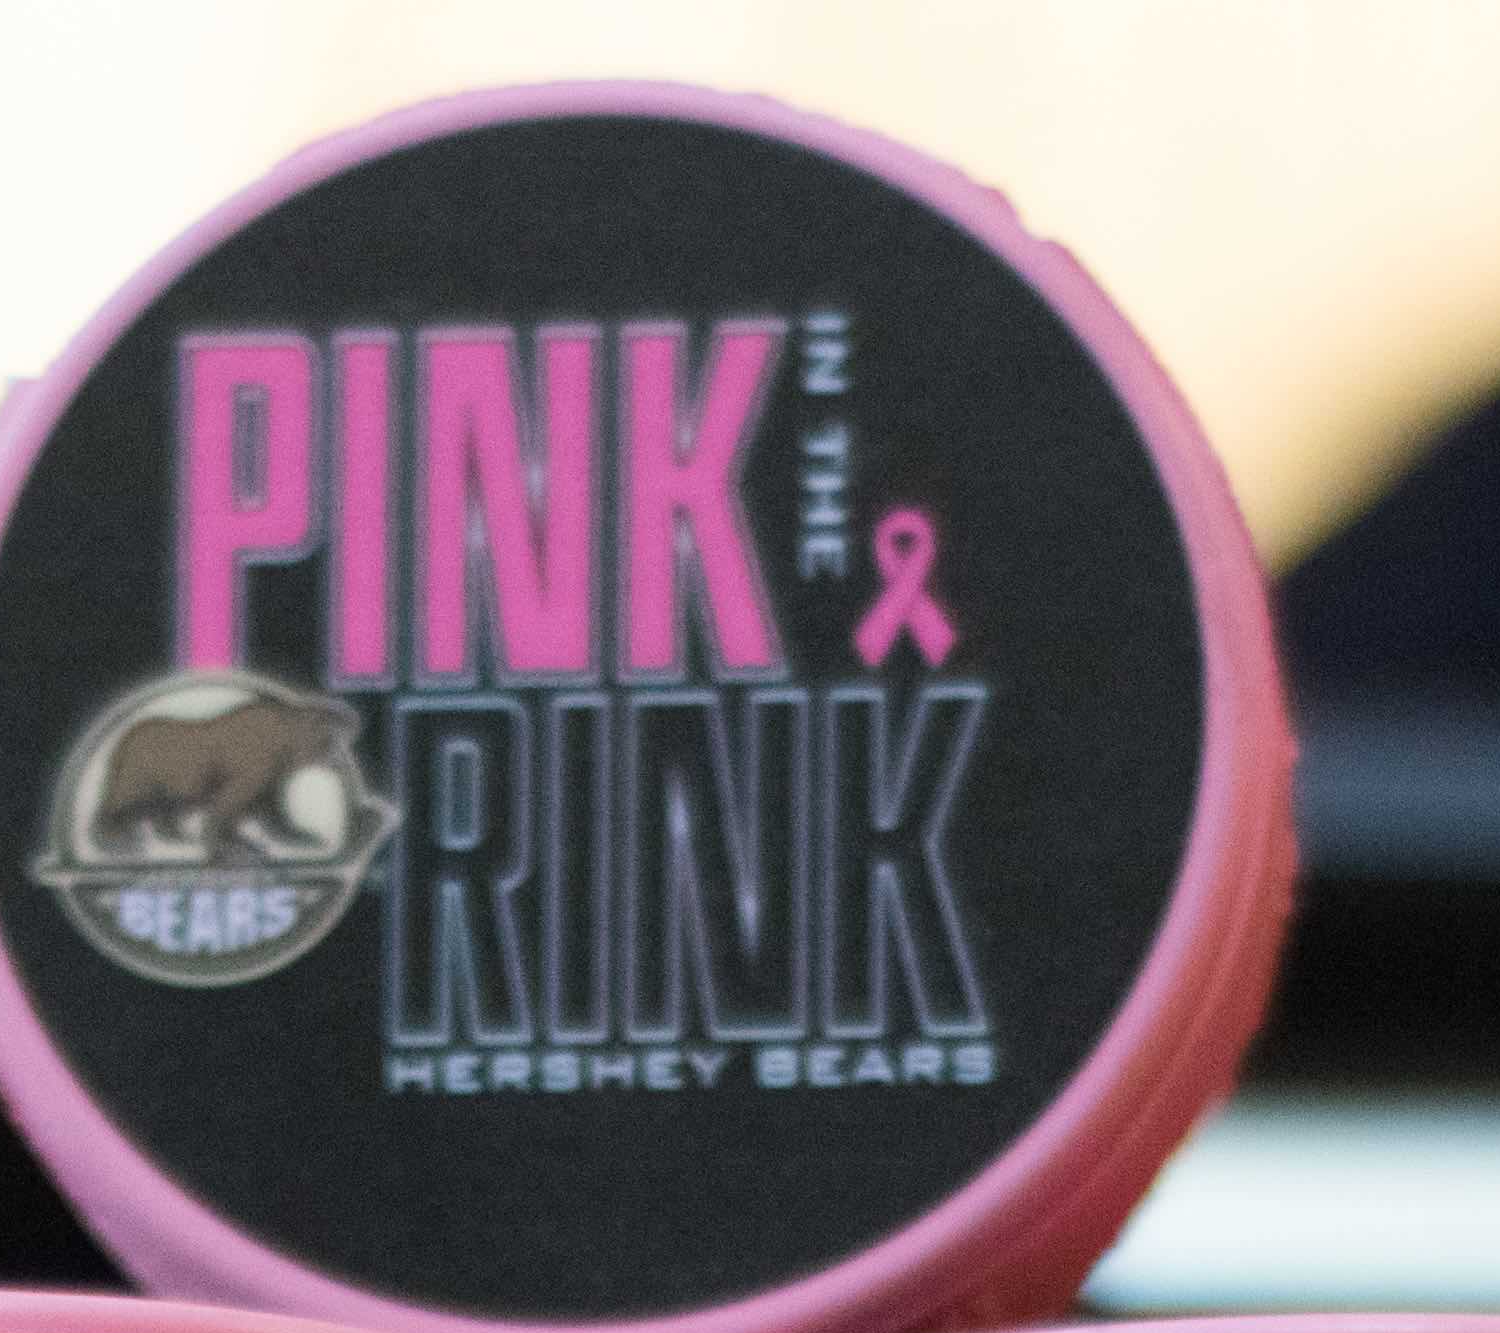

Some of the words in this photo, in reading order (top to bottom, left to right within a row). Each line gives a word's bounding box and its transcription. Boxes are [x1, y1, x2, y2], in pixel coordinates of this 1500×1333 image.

[804, 311, 850, 396] IN
[175, 317, 788, 690] PINK
[799, 418, 850, 578] THE
[117, 886, 298, 952] BEARS
[384, 681, 990, 1049] RINK
[388, 1048, 719, 1093] HERSHEY
[756, 1045, 997, 1090] BEARS
